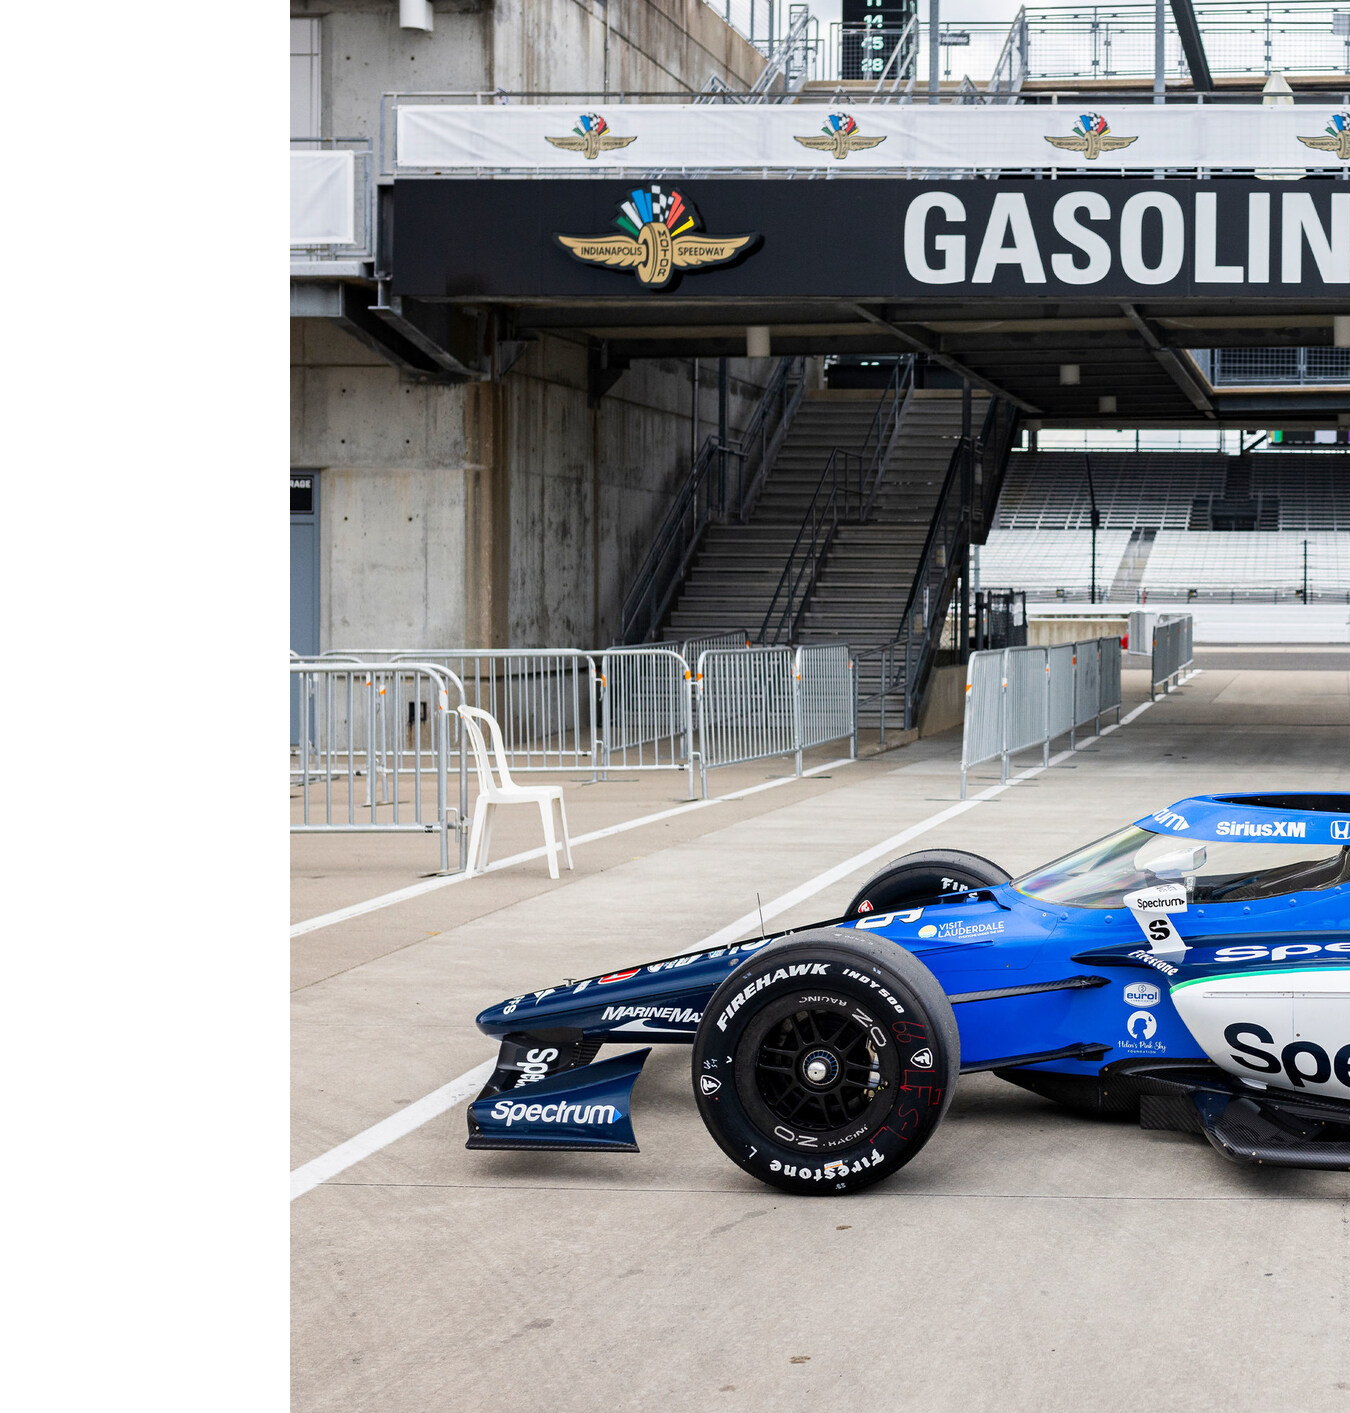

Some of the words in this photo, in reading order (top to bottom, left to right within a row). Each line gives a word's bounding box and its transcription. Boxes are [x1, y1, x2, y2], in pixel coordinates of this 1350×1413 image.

[581, 246, 643, 256] INDIANAPOLIS
[657, 230, 670, 277] MOTOR
[677, 246, 725, 256] SPEEDWAY
[1215, 820, 1306, 838] SiriusXM
[1137, 898, 1182, 910] Spectrum
[937, 920, 1005, 938] LAUDERDALE
[938, 920, 964, 931] VISIT
[1127, 949, 1179, 977] Firestone
[716, 962, 832, 1032] FIREHAWK
[1126, 991, 1157, 1000] eurol
[490, 1100, 616, 1126] Spectrum
[769, 1148, 885, 1182] Firestone
